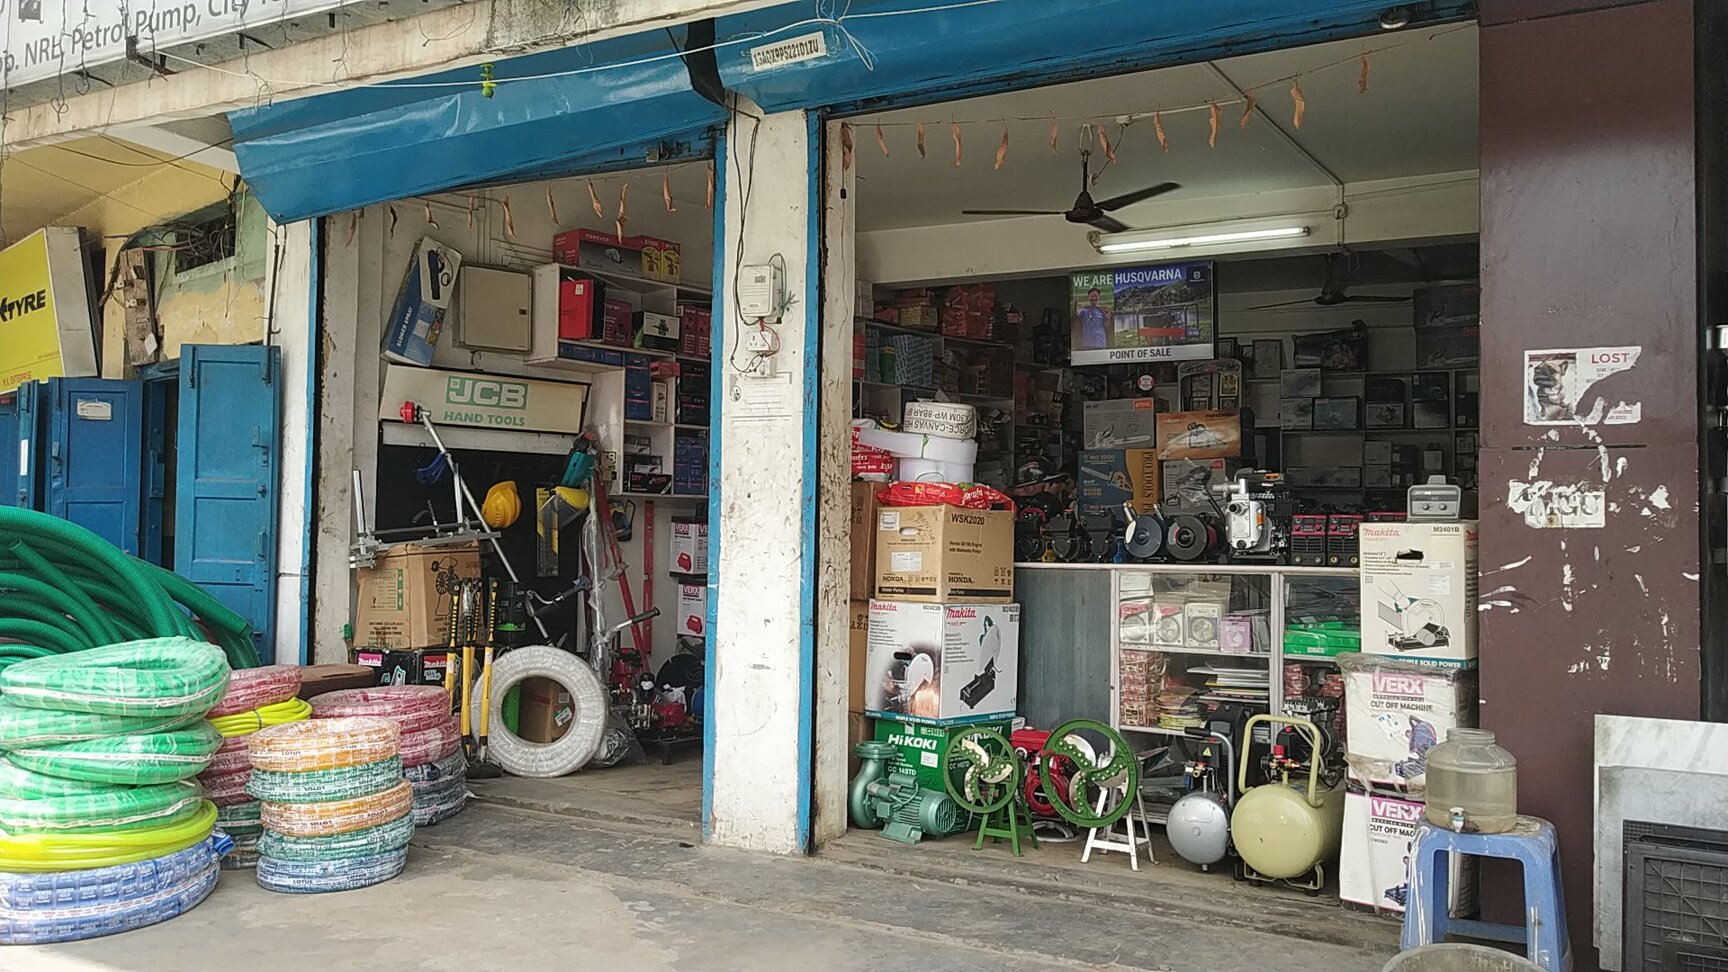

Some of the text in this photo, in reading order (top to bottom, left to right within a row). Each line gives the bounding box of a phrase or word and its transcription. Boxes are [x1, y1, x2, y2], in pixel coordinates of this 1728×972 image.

[71, 14, 130, 54] Petrol
[135, 9, 201, 36] Pump,
[1073, 268, 1182, 287] WE ARE HUSQVARNA
[1109, 347, 1172, 360] POINT OF SALE
[1591, 352, 1630, 365] LOST
[449, 378, 528, 408] JCB
[444, 411, 526, 427] HAND TOOLS
[951, 513, 985, 526] WSK2020
[675, 524, 689, 532] VERX
[683, 586, 699, 594] VERX
[1438, 661, 1462, 669] POWER
[1374, 678, 1424, 694] VERX
[1370, 700, 1434, 712] CUT OFF MACHINE
[898, 767, 918, 777] 14STD
[1372, 800, 1422, 821] VERX
[1369, 823, 1383, 832] CUT
[1384, 826, 1398, 835] OFF
